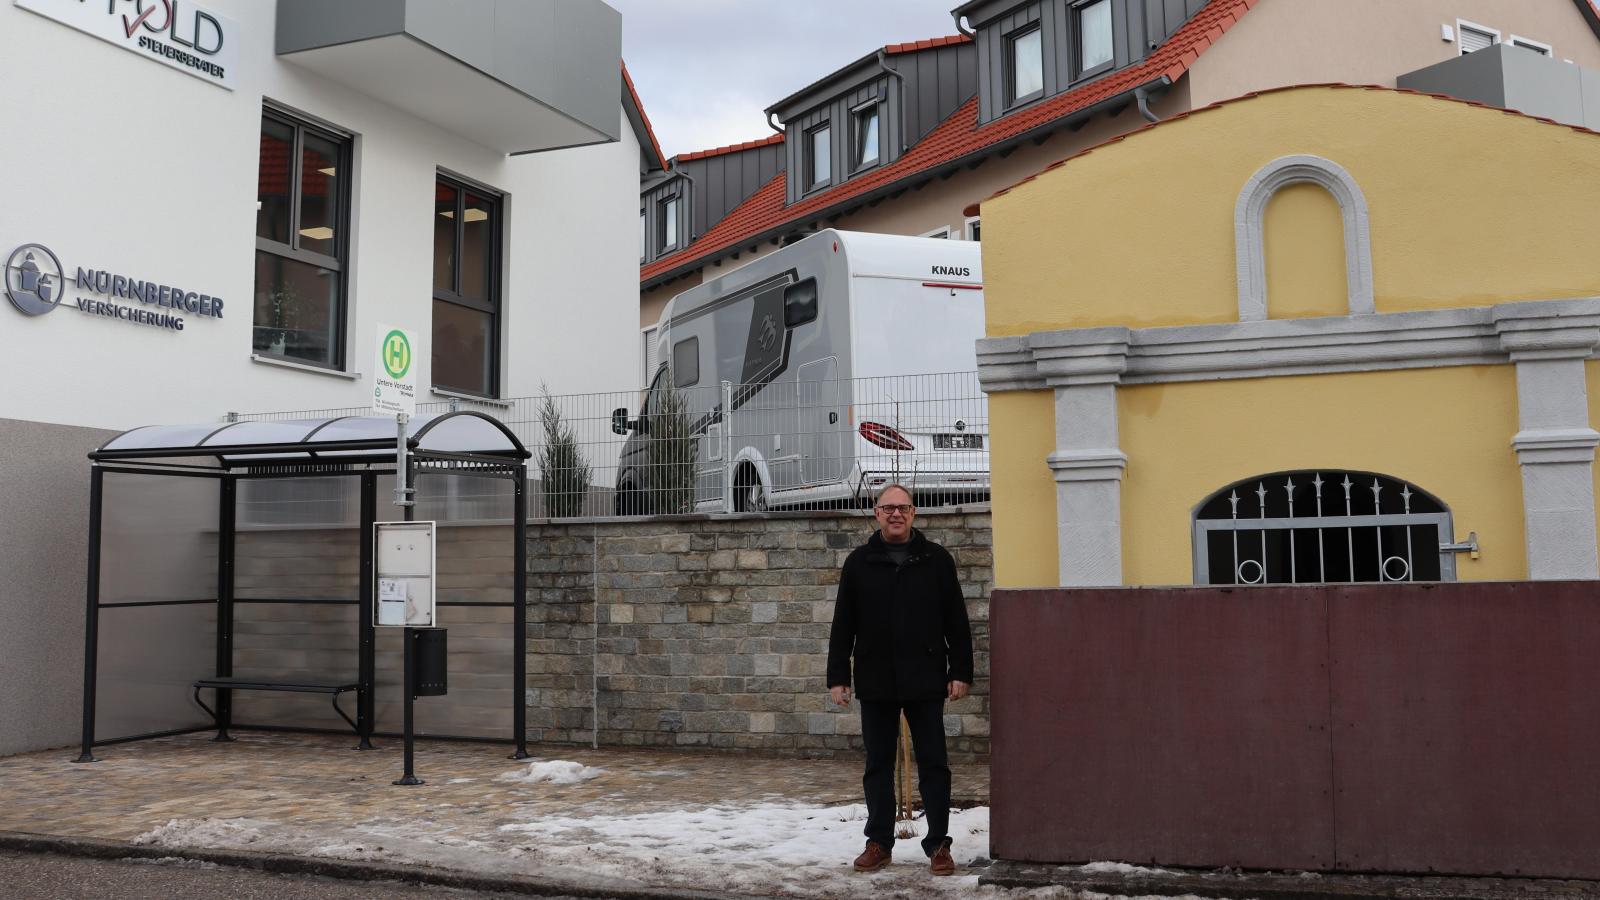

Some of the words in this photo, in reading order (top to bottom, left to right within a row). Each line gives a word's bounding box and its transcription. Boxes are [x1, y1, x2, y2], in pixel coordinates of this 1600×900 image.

[78, 0, 224, 55] OLD
[139, 36, 225, 79] STEUERBERATER
[931, 265, 970, 277] KNAUS
[77, 266, 224, 319] NÜRNBERGER
[76, 297, 184, 331] VERSICHERUNG
[390, 340, 404, 368] H
[376, 378, 393, 388] Untere
[394, 382, 413, 392] Vorstadt
